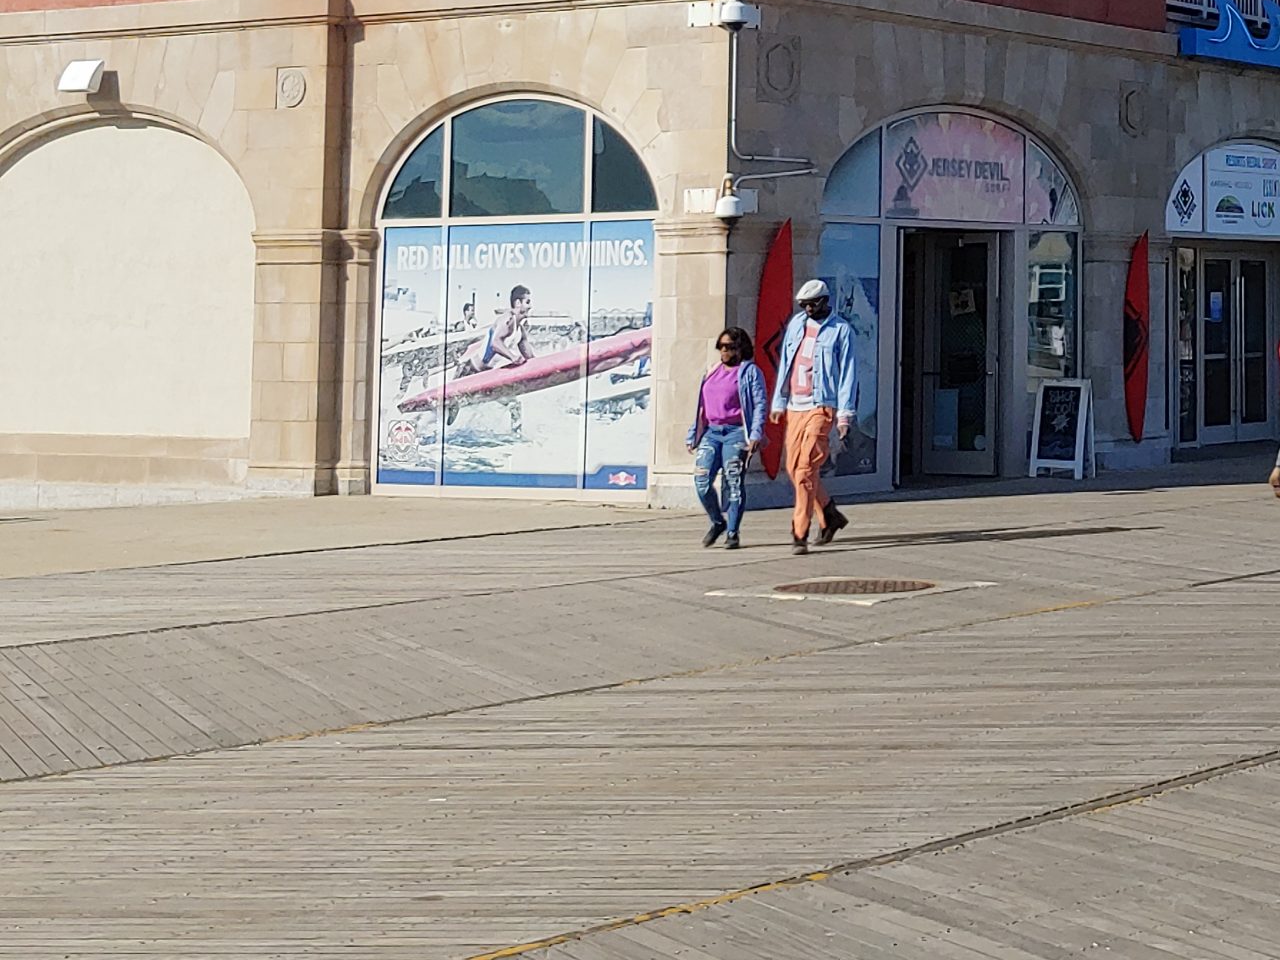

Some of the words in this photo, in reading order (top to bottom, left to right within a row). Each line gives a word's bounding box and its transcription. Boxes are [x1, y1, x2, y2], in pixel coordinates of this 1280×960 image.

[928, 157, 972, 179] JERSEY
[974, 160, 1010, 182] DEVIL
[1251, 200, 1276, 219] LICK
[397, 245, 429, 271] RED
[432, 243, 472, 271] BULL
[475, 242, 525, 270] GIVES
[529, 241, 567, 269] YOU
